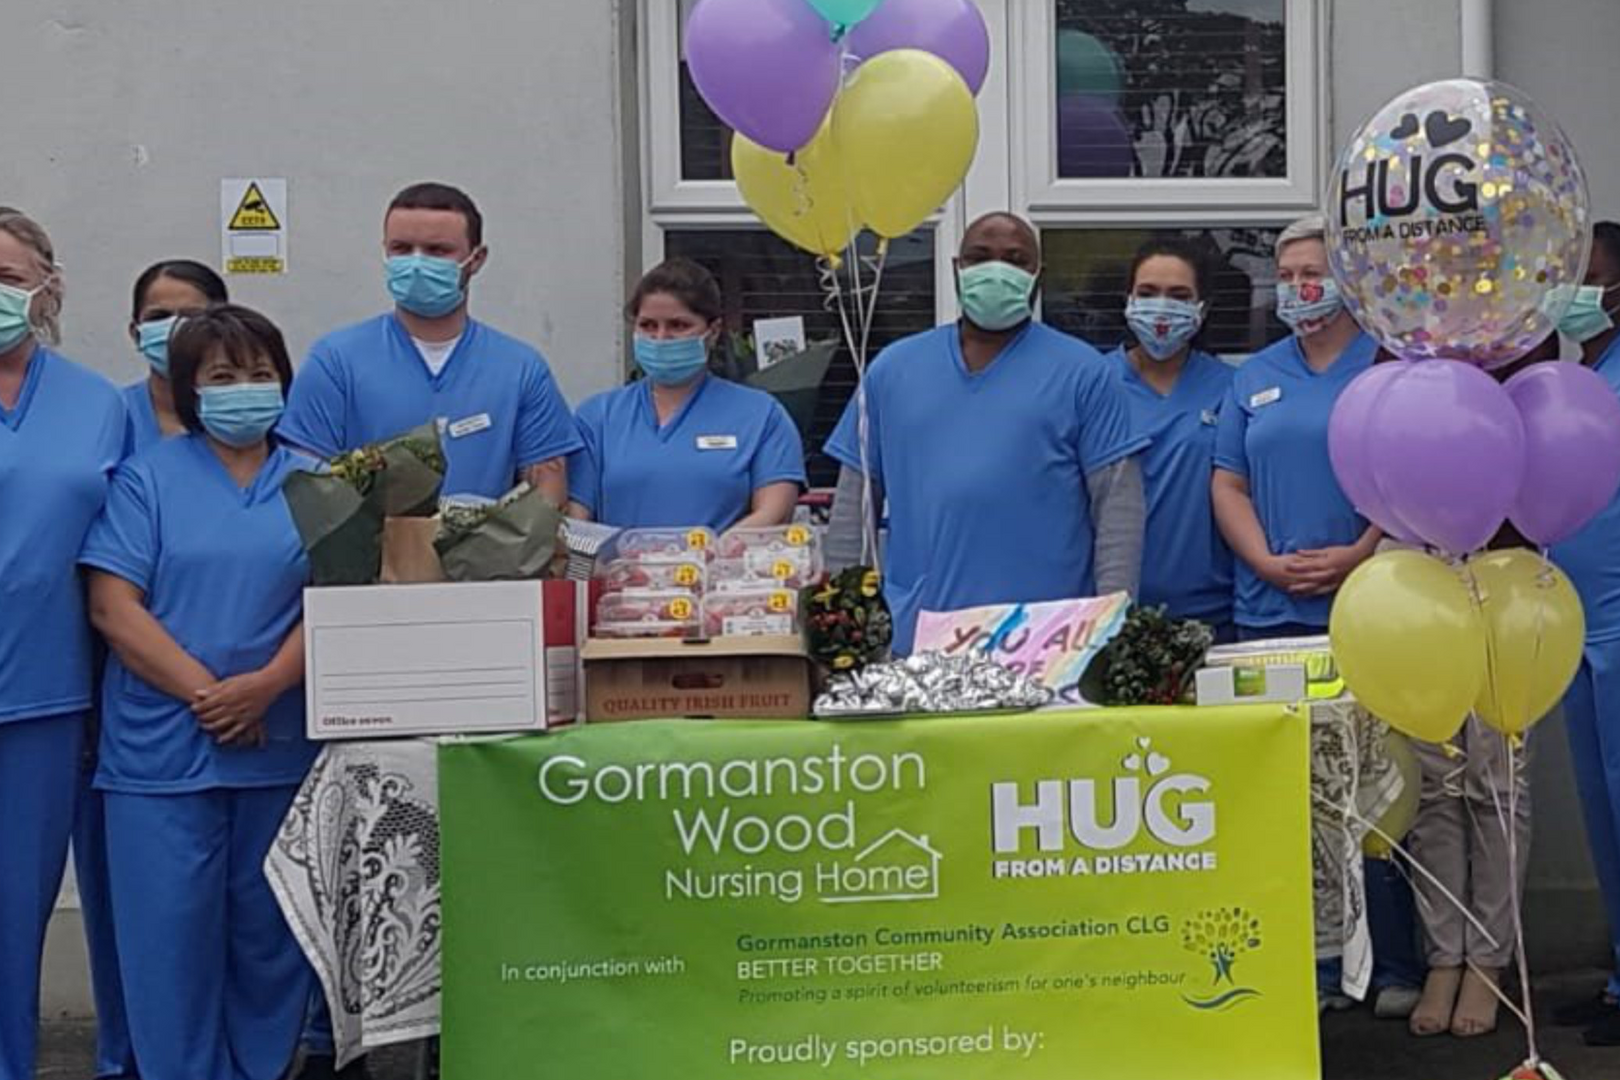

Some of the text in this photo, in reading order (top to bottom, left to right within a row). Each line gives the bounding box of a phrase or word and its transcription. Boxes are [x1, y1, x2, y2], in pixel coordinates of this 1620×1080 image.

[1340, 153, 1478, 227] HUG
[1383, 223, 1395, 238] A
[1400, 216, 1485, 239] DISTANCE
[603, 694, 790, 714] QUALITY IRISH FRUIT
[539, 744, 926, 804] Gormanston
[673, 800, 855, 855] Wood
[991, 773, 1216, 853] HUG
[666, 862, 929, 903] Nursing Home
[992, 851, 1217, 878] FROM A DISTANCE
[736, 915, 1169, 952] Gormanston Community Association CLG
[501, 955, 686, 983] In conjunction with
[737, 952, 943, 979] BETTER TOGETHER
[738, 971, 1186, 1004] Promoting a spirit of volunteerism for one's neighbour
[730, 1027, 1045, 1067] Proudly sponsored by:
